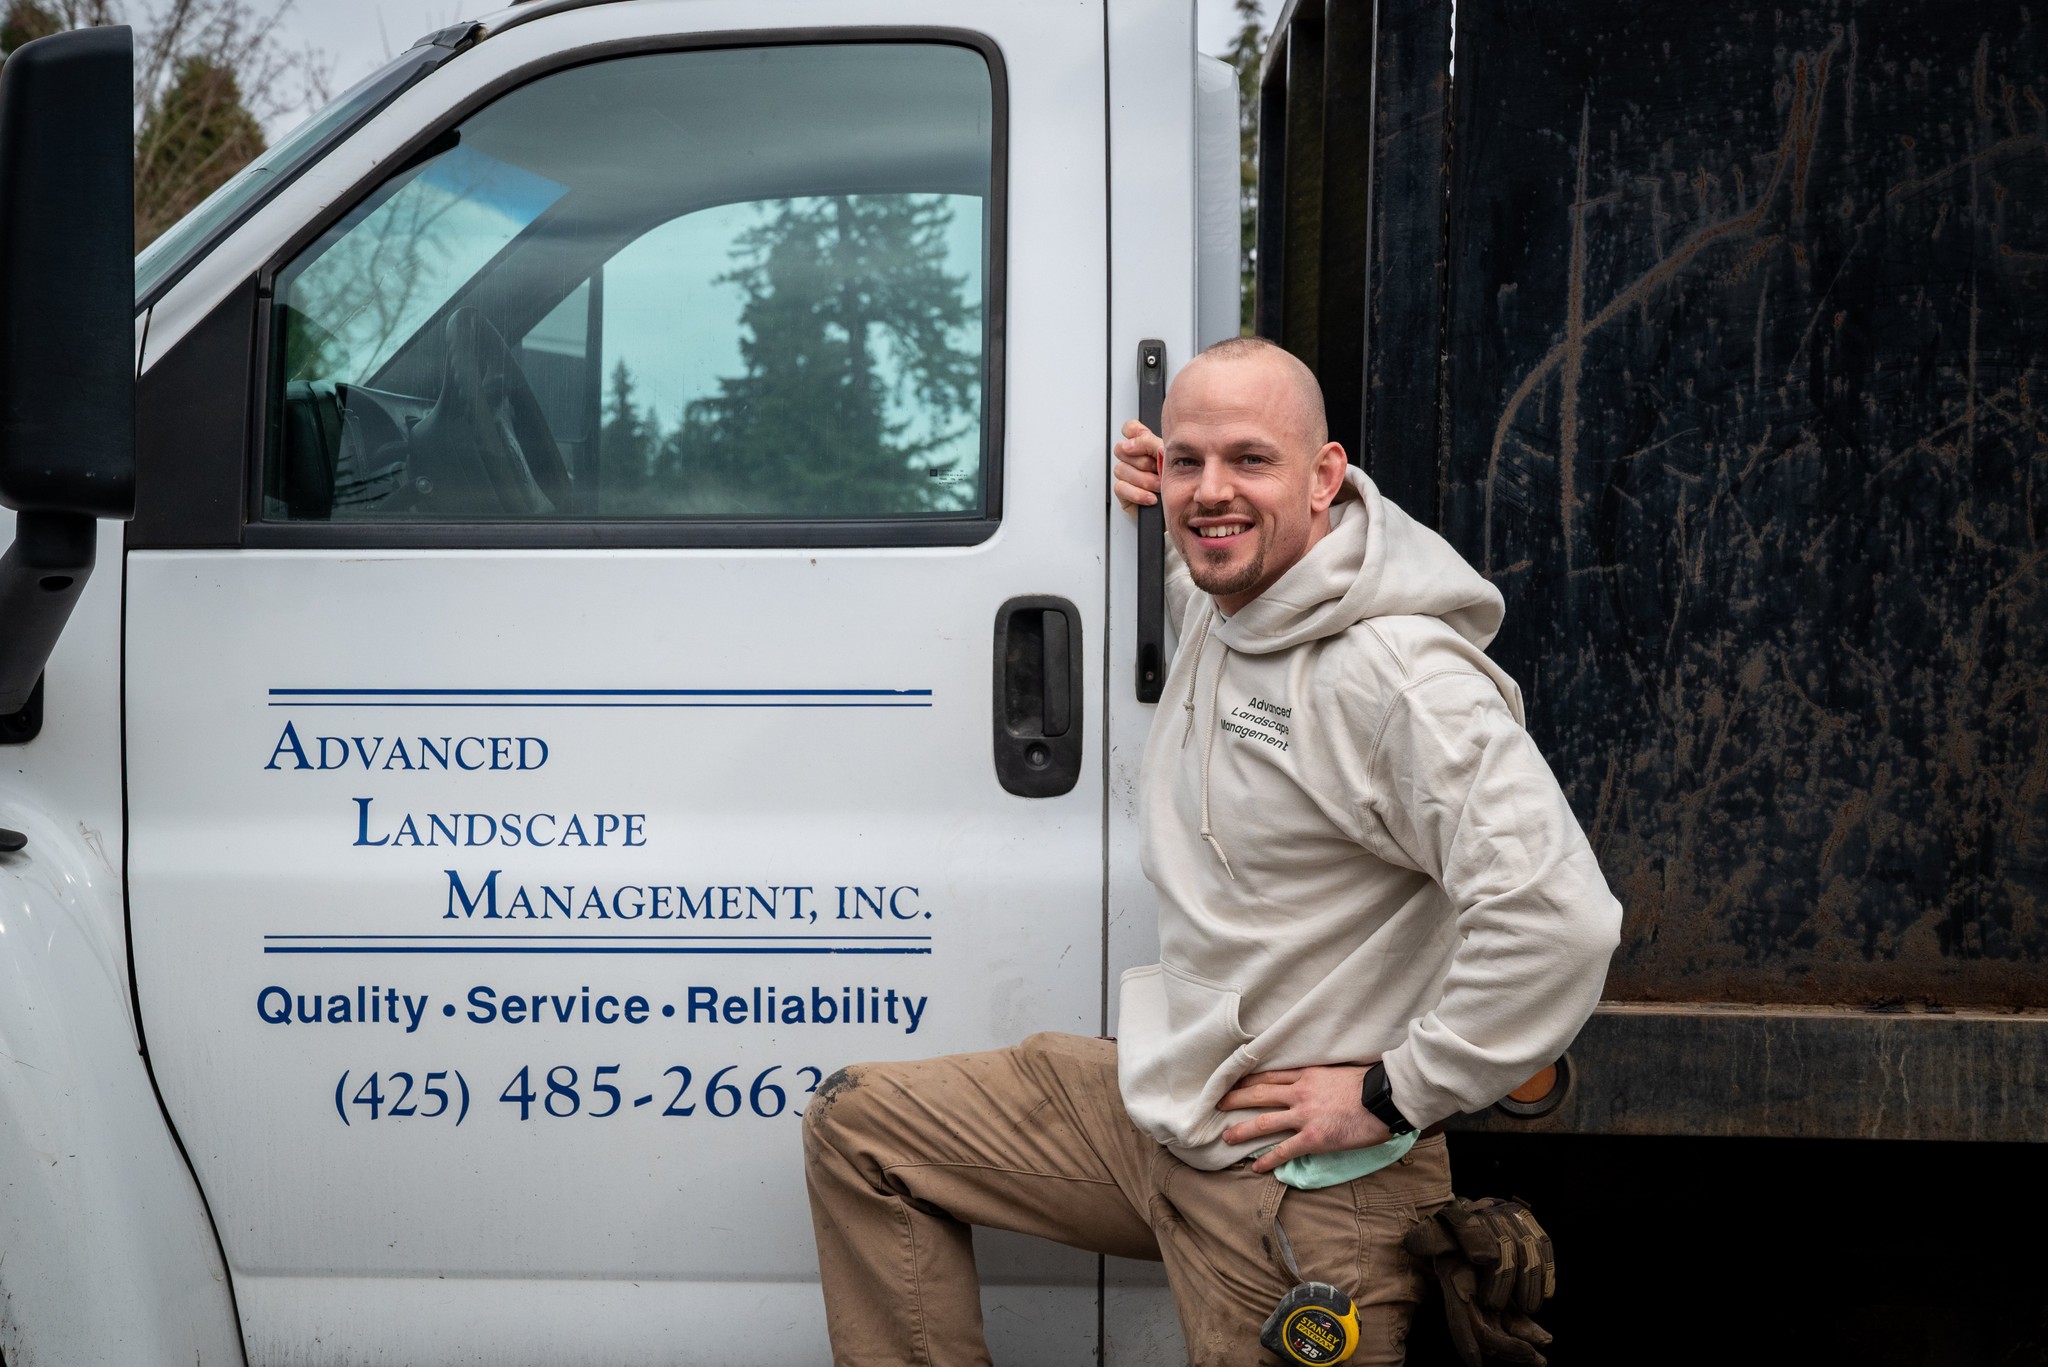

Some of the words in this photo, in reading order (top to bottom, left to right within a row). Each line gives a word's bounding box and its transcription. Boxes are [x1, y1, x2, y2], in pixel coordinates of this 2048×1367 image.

[1248, 697, 1292, 719] Advanced
[264, 719, 550, 771] ADVANCED
[351, 796, 647, 847] LANDSCAPE
[442, 869, 818, 924] MANAGEMENT,
[835, 884, 933, 921] INC.
[256, 985, 429, 1035] Quality
[466, 985, 651, 1026] Service
[686, 985, 928, 1035] Reliability
[334, 1070, 471, 1126] (425)
[1298, 1324, 1333, 1350] FATMAX
[1300, 1316, 1340, 1344] STANLEY
